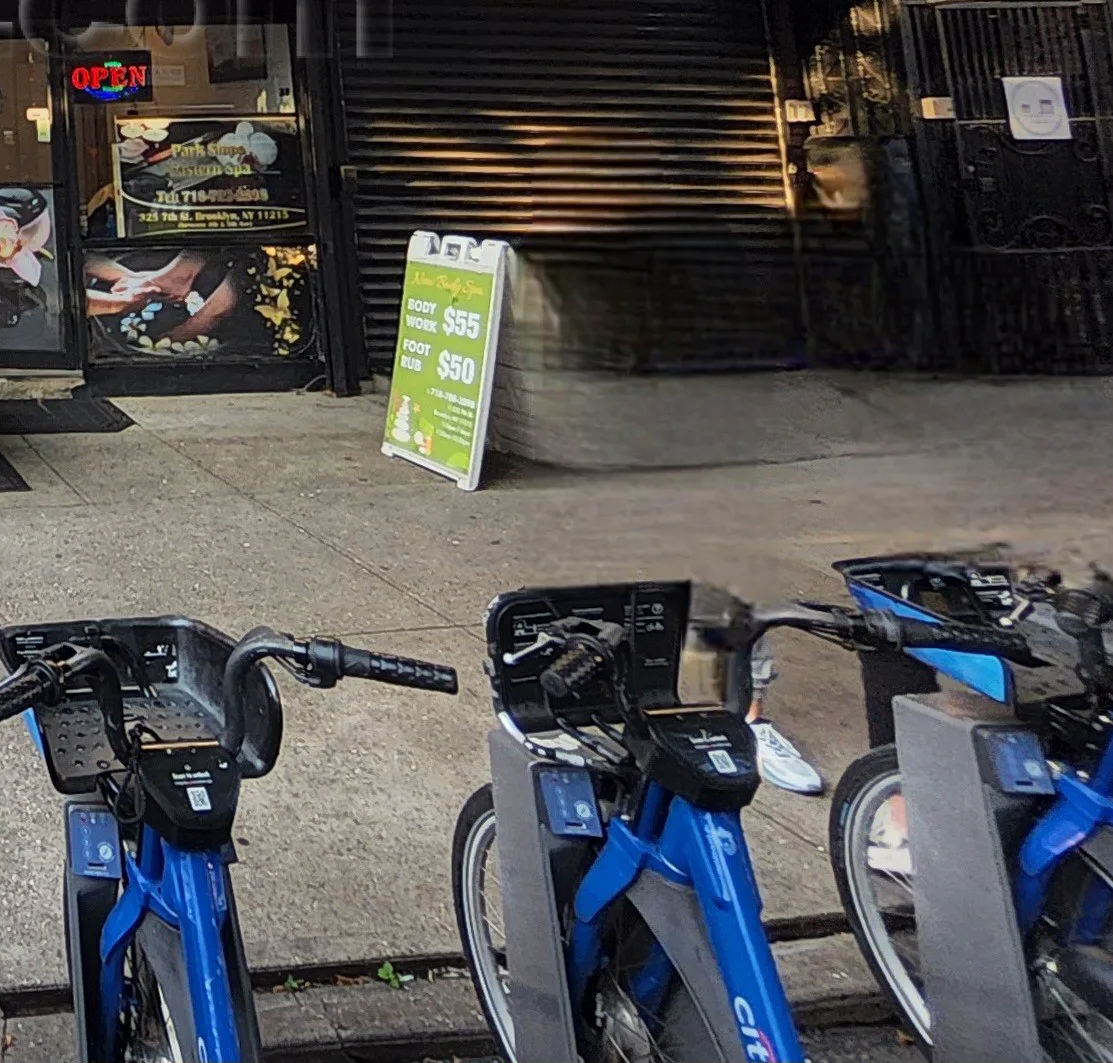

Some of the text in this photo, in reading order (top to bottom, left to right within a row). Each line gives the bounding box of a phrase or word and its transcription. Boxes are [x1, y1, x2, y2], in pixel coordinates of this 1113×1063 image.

[71, 65, 147, 90] OPEN
[407, 298, 437, 315] BODY
[405, 314, 438, 334] WORK
[442, 305, 481, 340] $55
[402, 338, 431, 356] FOOT
[400, 354, 422, 372] RUB
[437, 349, 475, 384] $50
